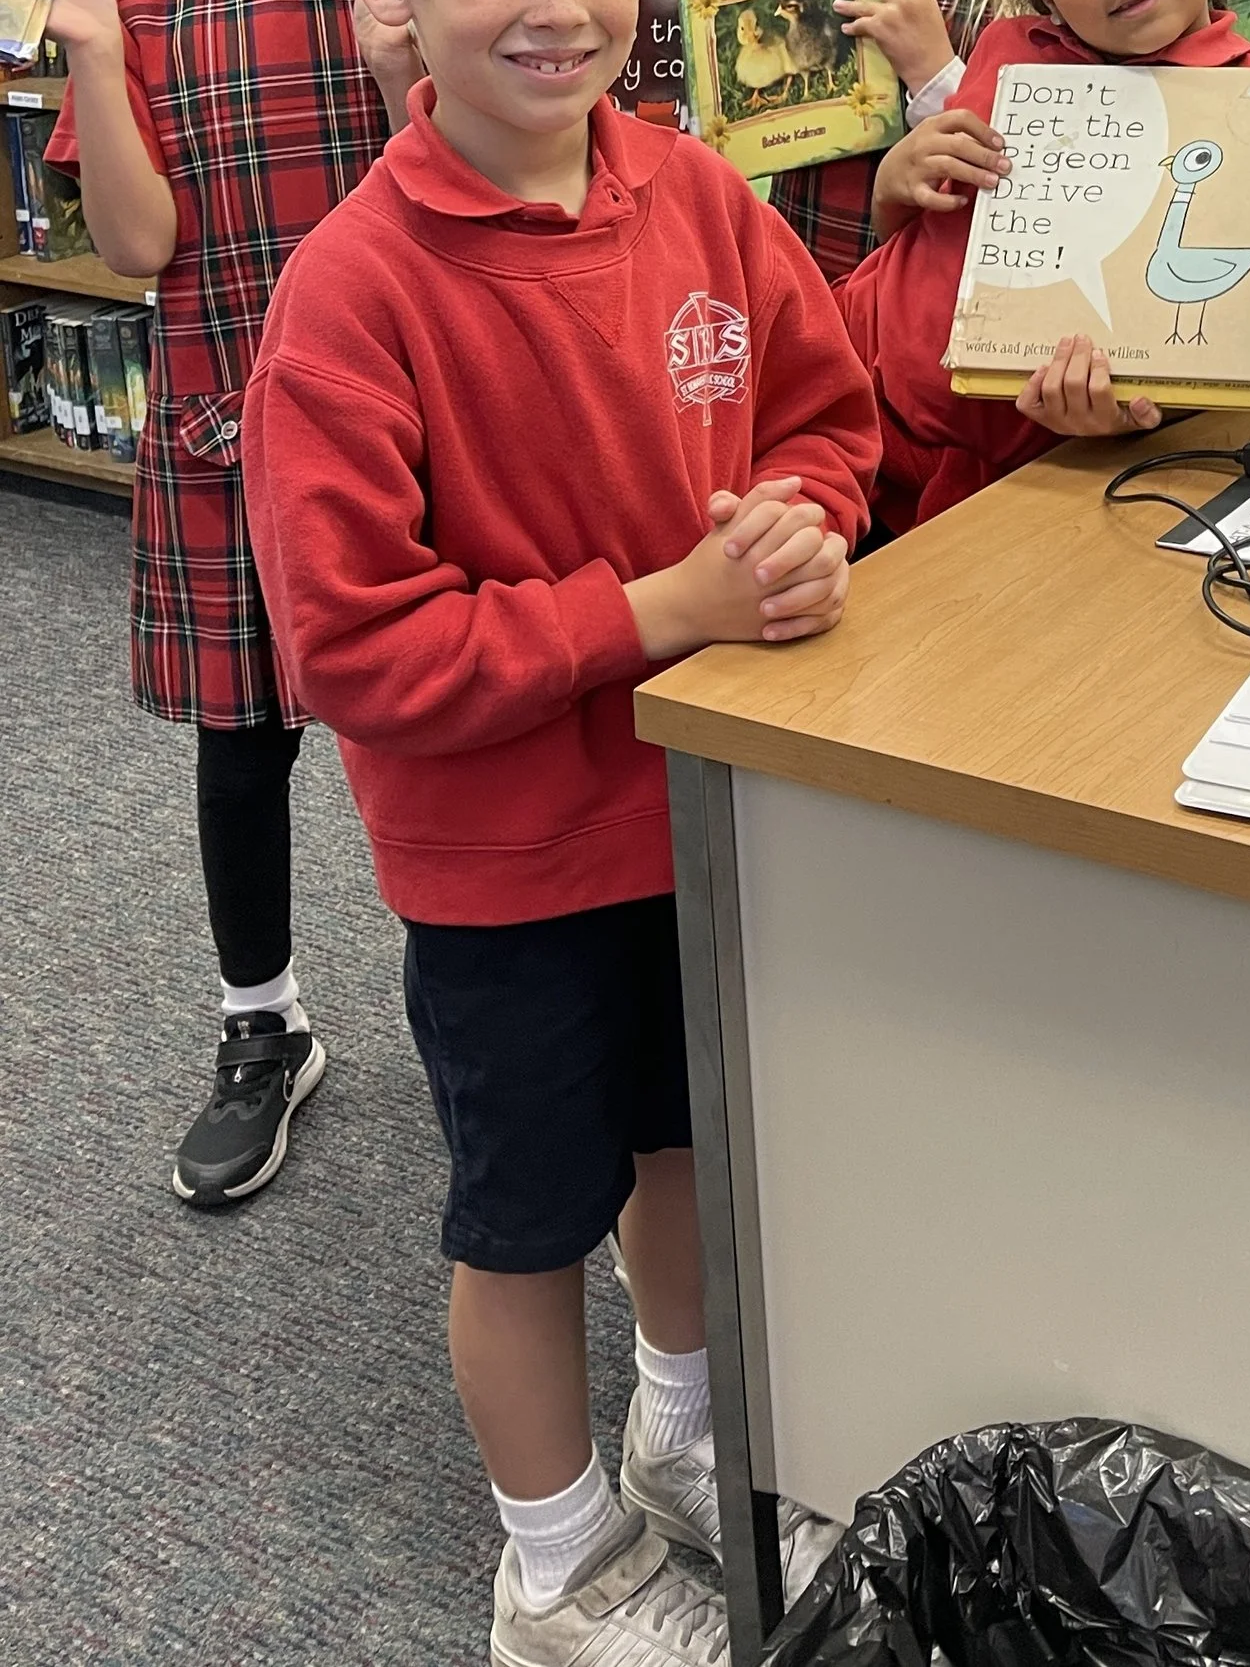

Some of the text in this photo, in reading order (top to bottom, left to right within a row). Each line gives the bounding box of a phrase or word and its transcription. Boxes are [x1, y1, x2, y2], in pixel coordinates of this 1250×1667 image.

[1009, 82, 1116, 106] Don't
[1003, 114, 1144, 139] Let the
[761, 133, 791, 149] Bobbie
[991, 177, 1103, 203] Drive
[989, 210, 1052, 235] the
[978, 244, 1064, 270] Bus!
[965, 339, 998, 354] words
[1000, 342, 1020, 354] and
[1107, 346, 1151, 360] willems
